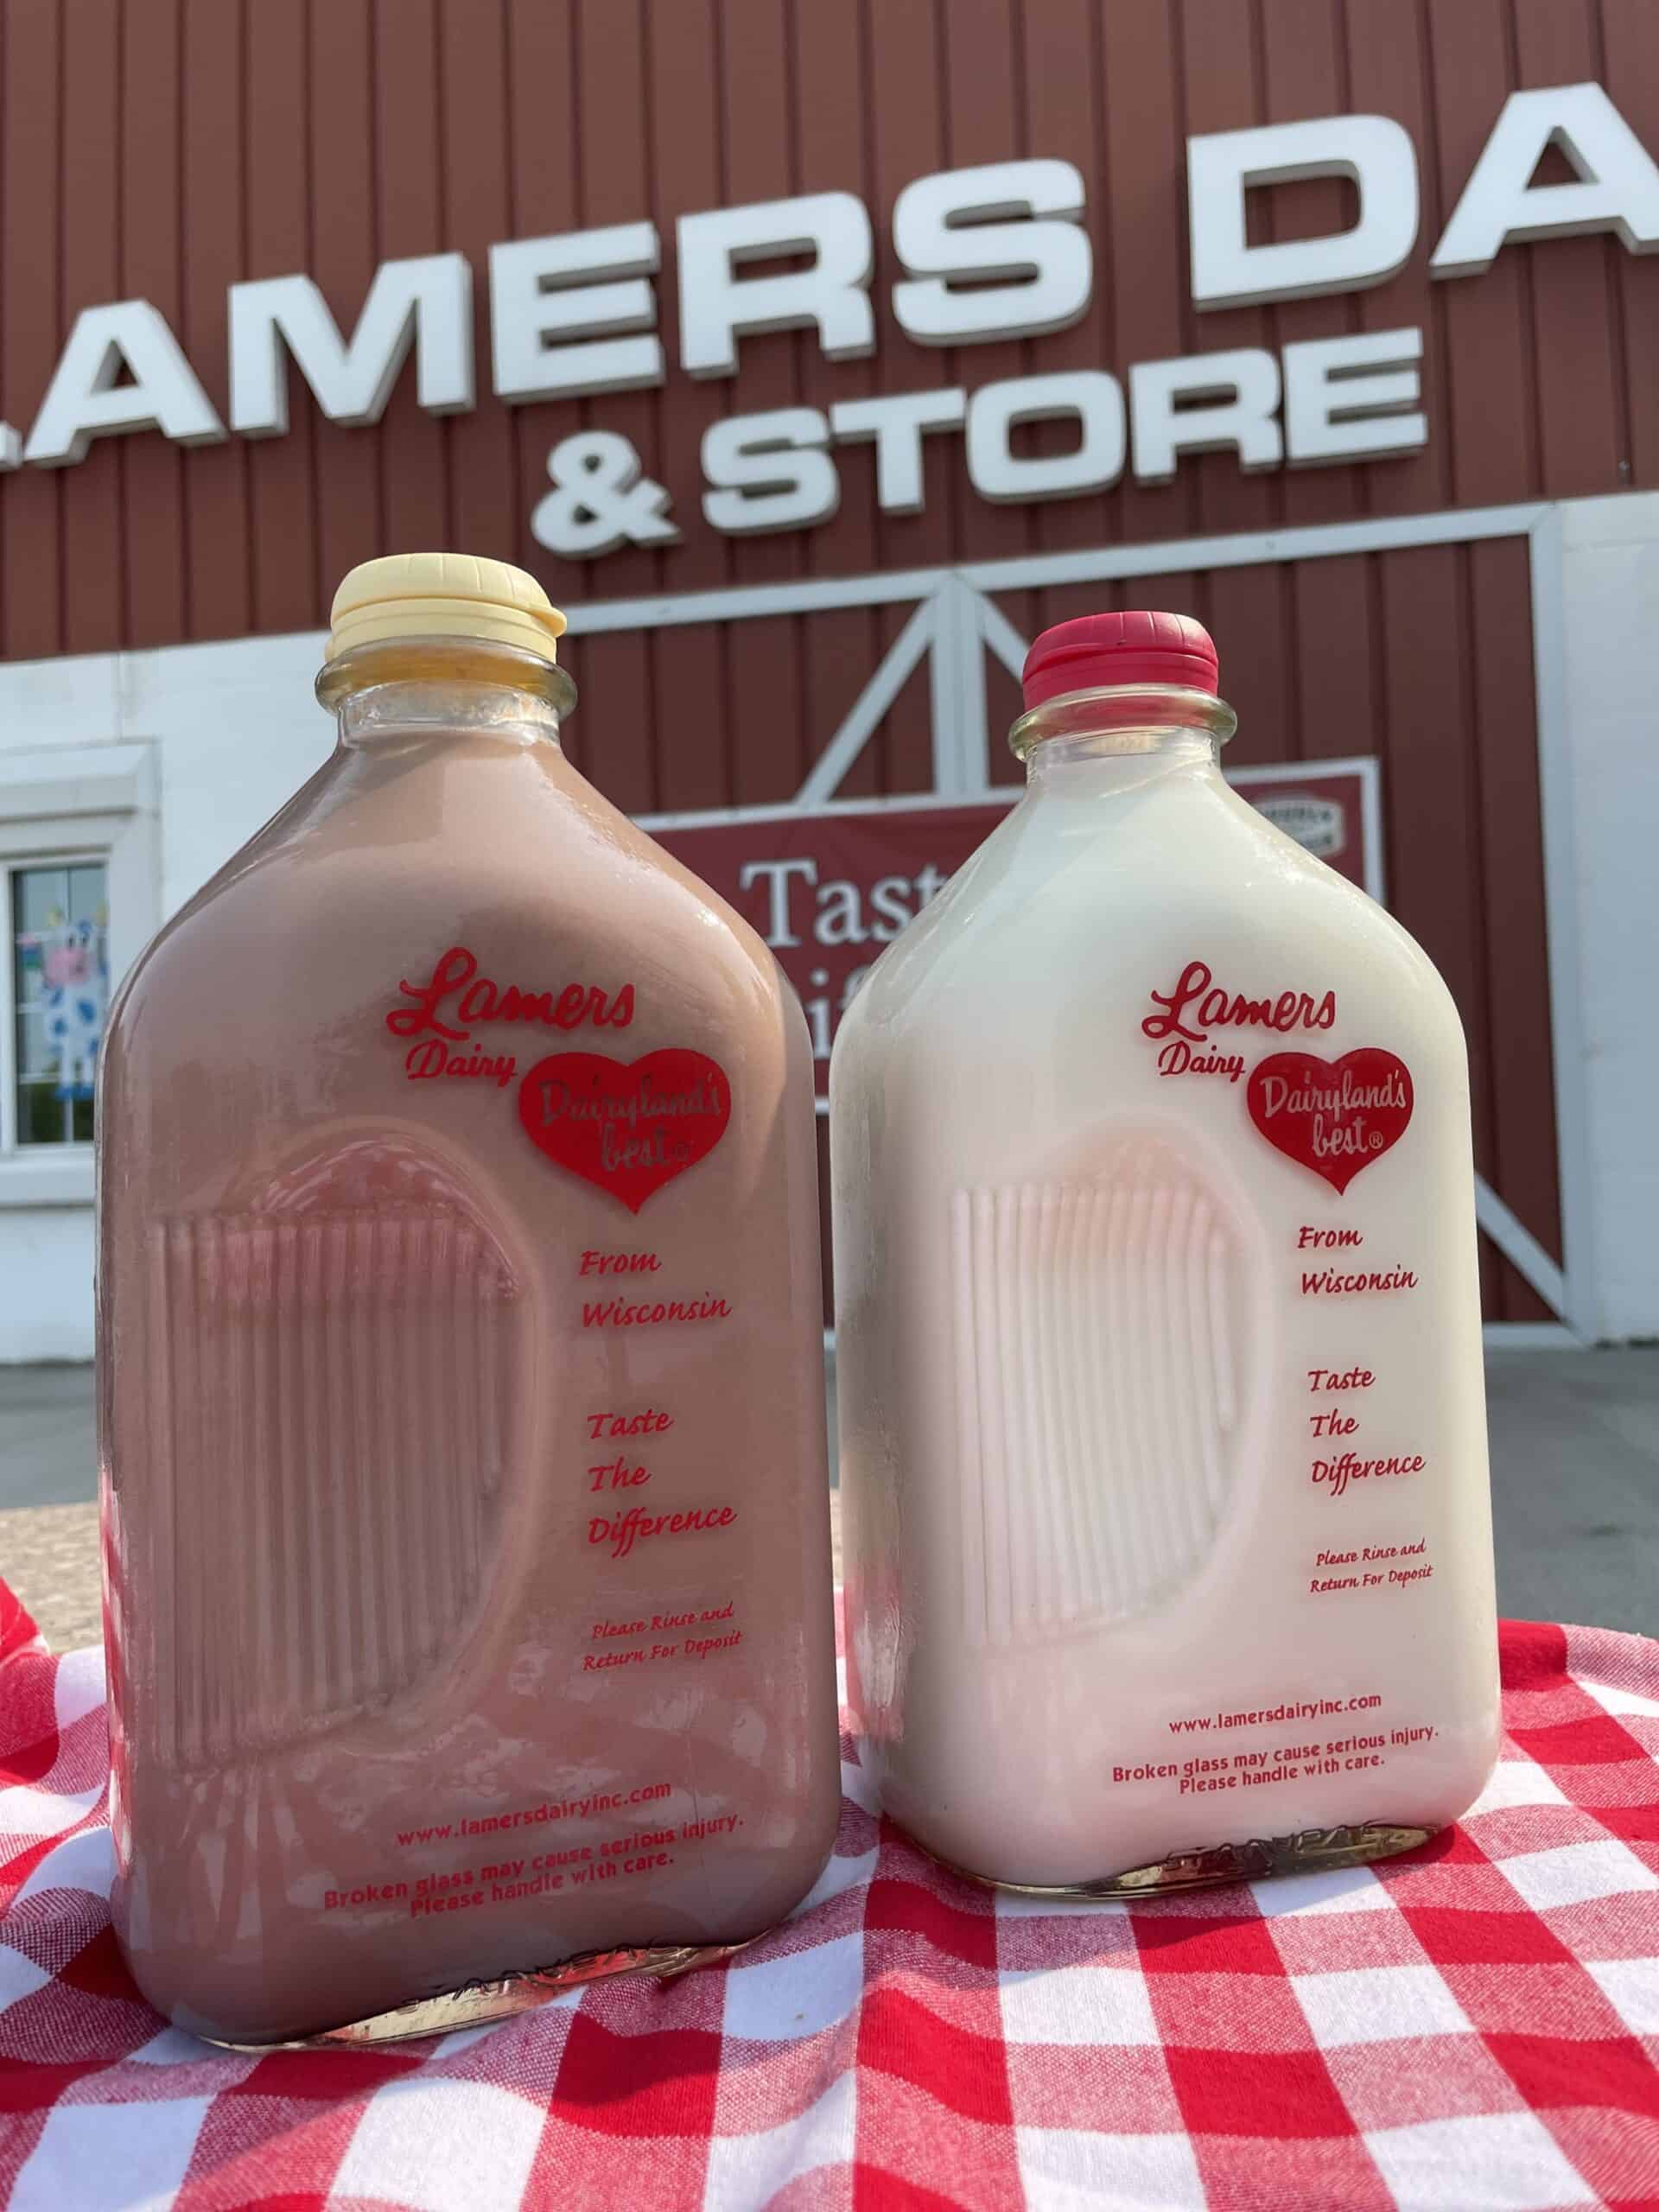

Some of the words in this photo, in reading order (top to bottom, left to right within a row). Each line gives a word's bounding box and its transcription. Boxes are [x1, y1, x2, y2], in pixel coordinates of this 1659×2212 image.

[0, 158, 1093, 472] AMERS
[531, 430, 681, 560] &
[700, 327, 1428, 536] STORE
[385, 946, 635, 1041] Lamers
[1141, 961, 1336, 1042] Lamers
[405, 1039, 517, 1088] Dairy
[1158, 1040, 1245, 1083] Dairy
[1259, 1070, 1407, 1119] Dairyland's
[1297, 1226, 1363, 1249] From
[579, 1250, 662, 1276] From
[1301, 1263, 1419, 1294] Wisconsin
[582, 1291, 733, 1327] Wisconsin
[1307, 1367, 1376, 1392] Taste
[587, 1408, 675, 1440] Taste
[1310, 1408, 1360, 1438] The
[588, 1456, 652, 1492] The
[1312, 1452, 1427, 1497] Difference
[588, 1506, 739, 1559] Difference
[1316, 1549, 1358, 1567] Please
[1362, 1545, 1398, 1561] Rinse
[1400, 1536, 1427, 1554] and
[1310, 1576, 1359, 1592] Return
[1363, 1573, 1384, 1586] For
[1389, 1563, 1433, 1588] Deposit
[592, 1620, 647, 1639] Please
[651, 1611, 696, 1631] Rinse
[701, 1600, 734, 1622] and
[582, 1650, 645, 1671] Return
[650, 1644, 679, 1660] For
[683, 1630, 743, 1659] Deposit
[1169, 1694, 1382, 1734] www.lamersdairyinc.com
[1113, 1764, 1178, 1783] Broken
[1183, 1758, 1229, 1778] glass
[1234, 1751, 1268, 1769] may
[1274, 1743, 1320, 1763] cause
[1325, 1733, 1386, 1755] serious
[1390, 1726, 1439, 1747] injury.
[1179, 1777, 1236, 1794] Please
[1243, 1766, 1298, 1786] handle
[1304, 1760, 1340, 1776] with
[1345, 1754, 1385, 1771] care.
[397, 1781, 672, 1847] www.lamersdairyinc.com
[323, 1880, 408, 1910] Broken
[416, 1870, 474, 1898] glass
[480, 1859, 526, 1881] may
[531, 1848, 592, 1872] cause
[600, 1829, 676, 1857] serious
[682, 1813, 744, 1840] injury.
[410, 1891, 484, 1918] Please
[491, 1874, 564, 1902] handle
[570, 1861, 617, 1886] with
[622, 1853, 674, 1874] care.
